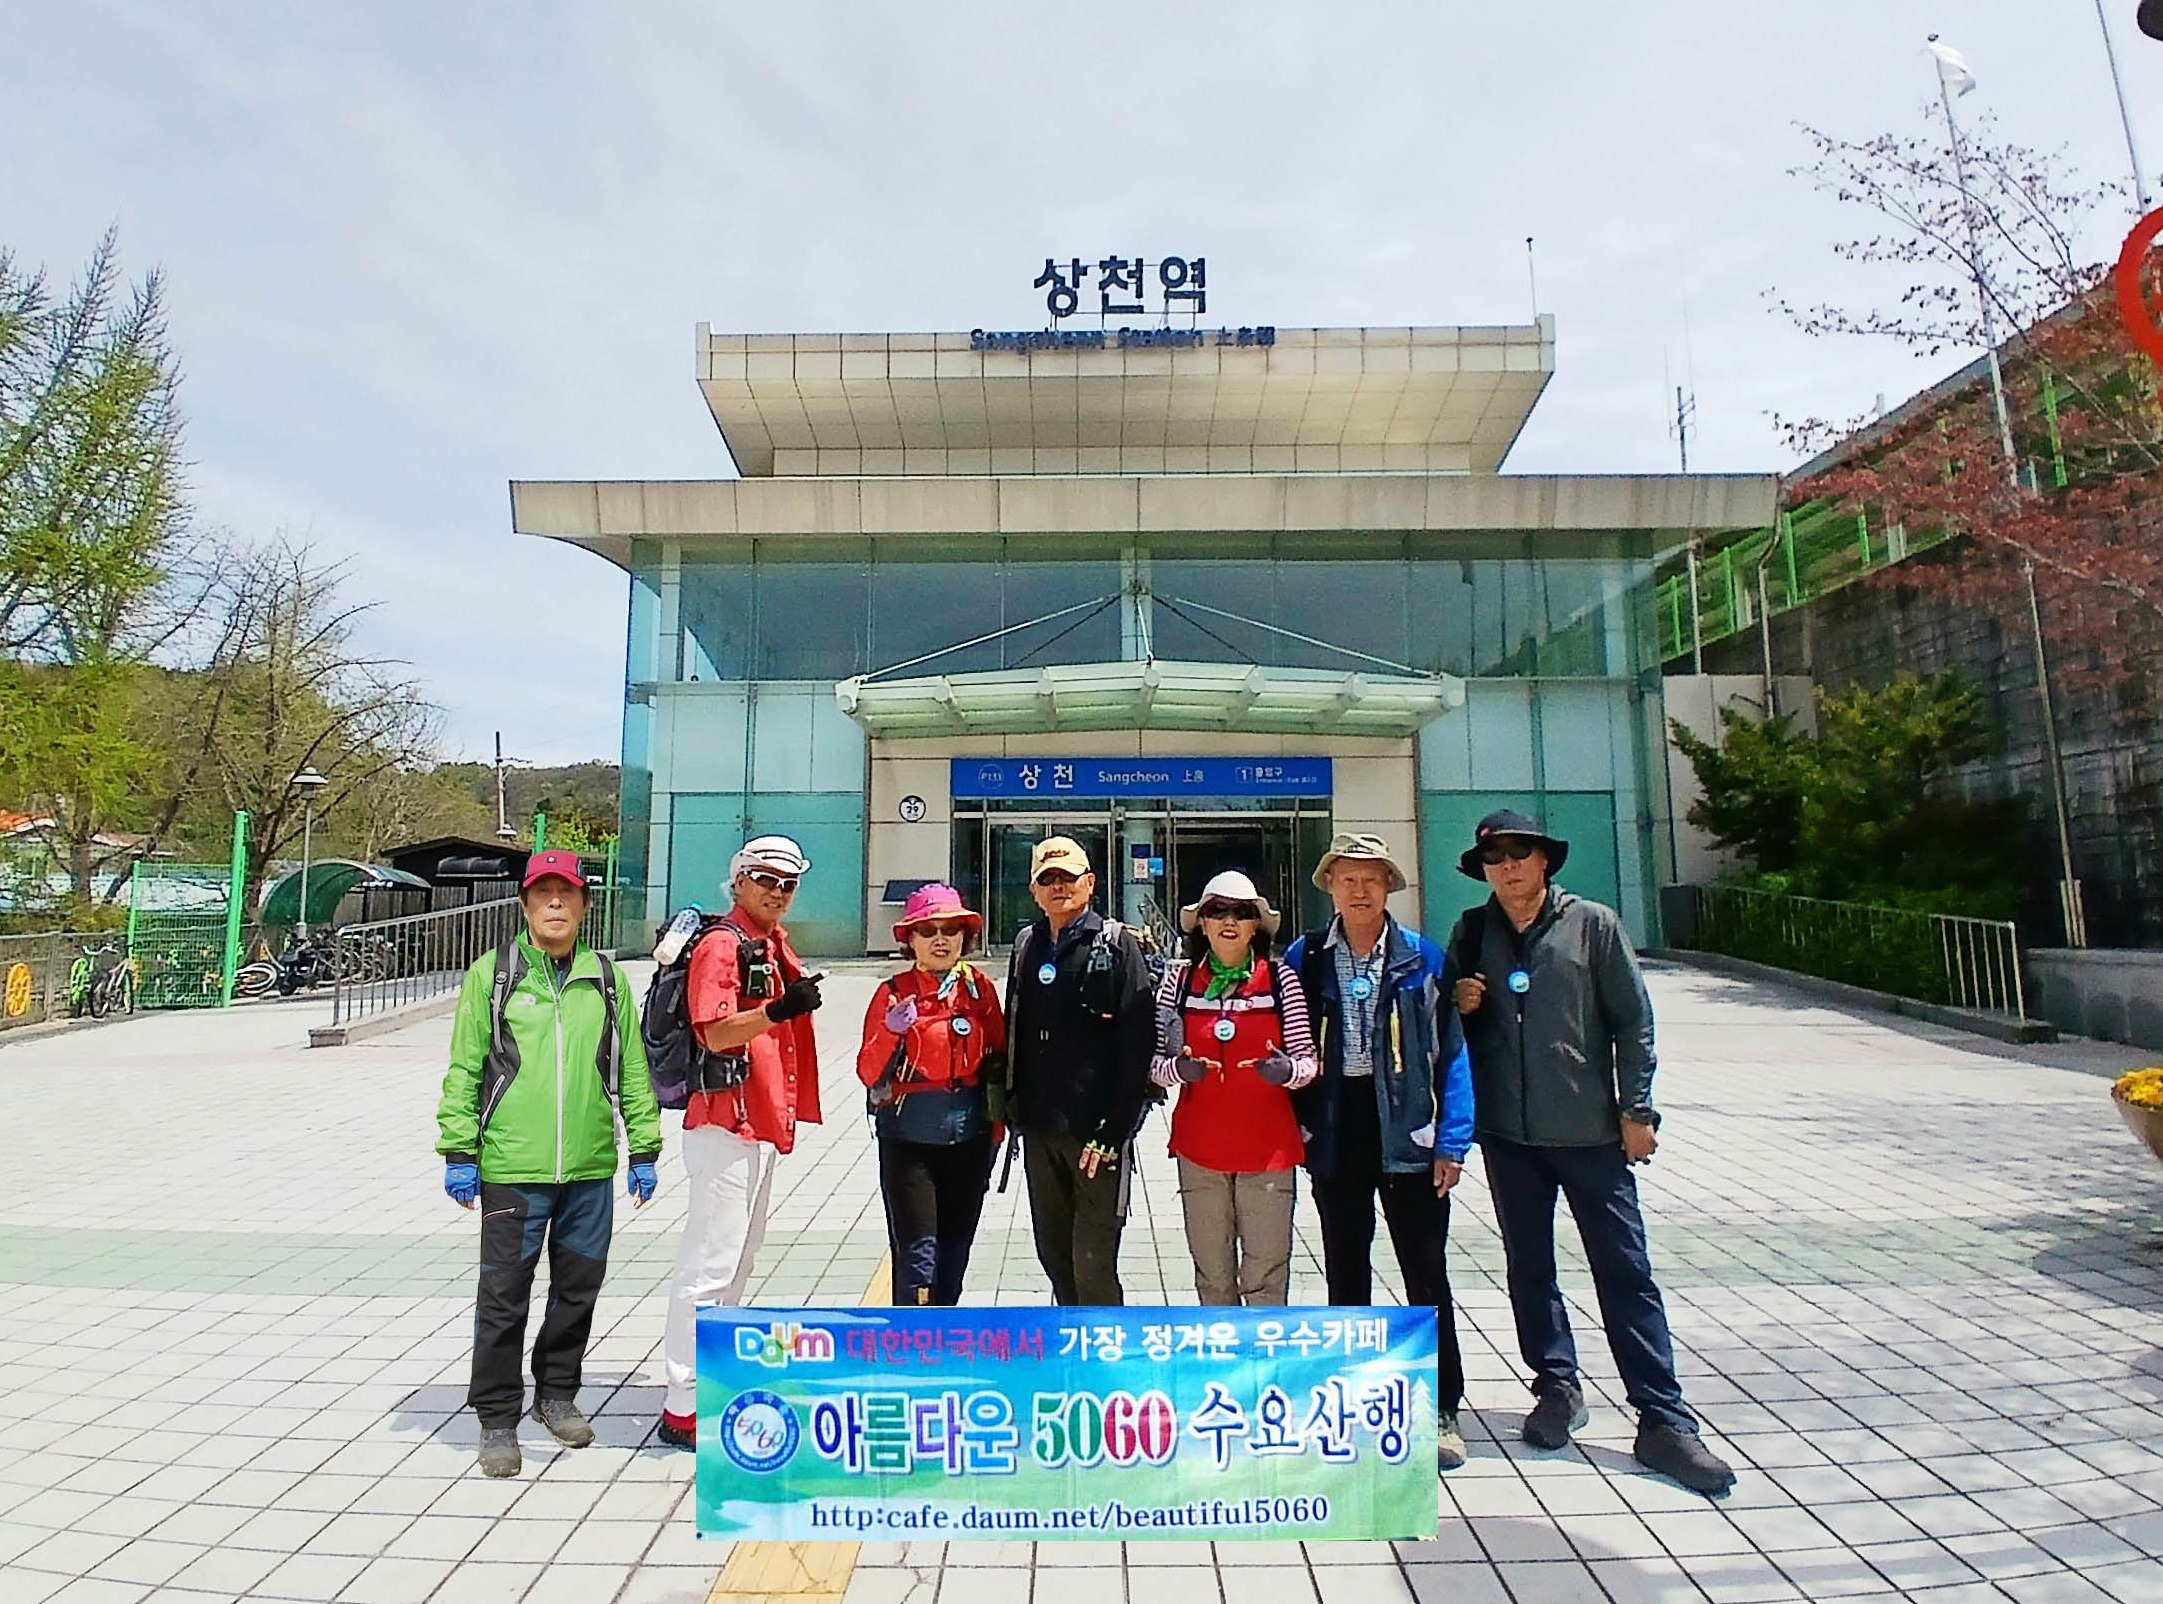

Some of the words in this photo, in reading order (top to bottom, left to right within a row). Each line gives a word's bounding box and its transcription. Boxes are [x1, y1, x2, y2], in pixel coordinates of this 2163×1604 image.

[1033, 255, 1207, 317] 상천역
[1098, 771, 1170, 785] Sangcheon
[735, 1322, 834, 1368] Daum
[846, 1327, 1044, 1365] 대한민국에서
[1059, 1324, 1127, 1363] 가장
[1141, 1321, 1241, 1362] 정겨운
[1254, 1316, 1388, 1357] 우수카페
[812, 1392, 1016, 1472] 아름다운
[1033, 1394, 1175, 1464] 5060
[1193, 1379, 1412, 1465] 수요산행
[811, 1496, 1328, 1531] http:cafe.daum.net/beautiful5060
